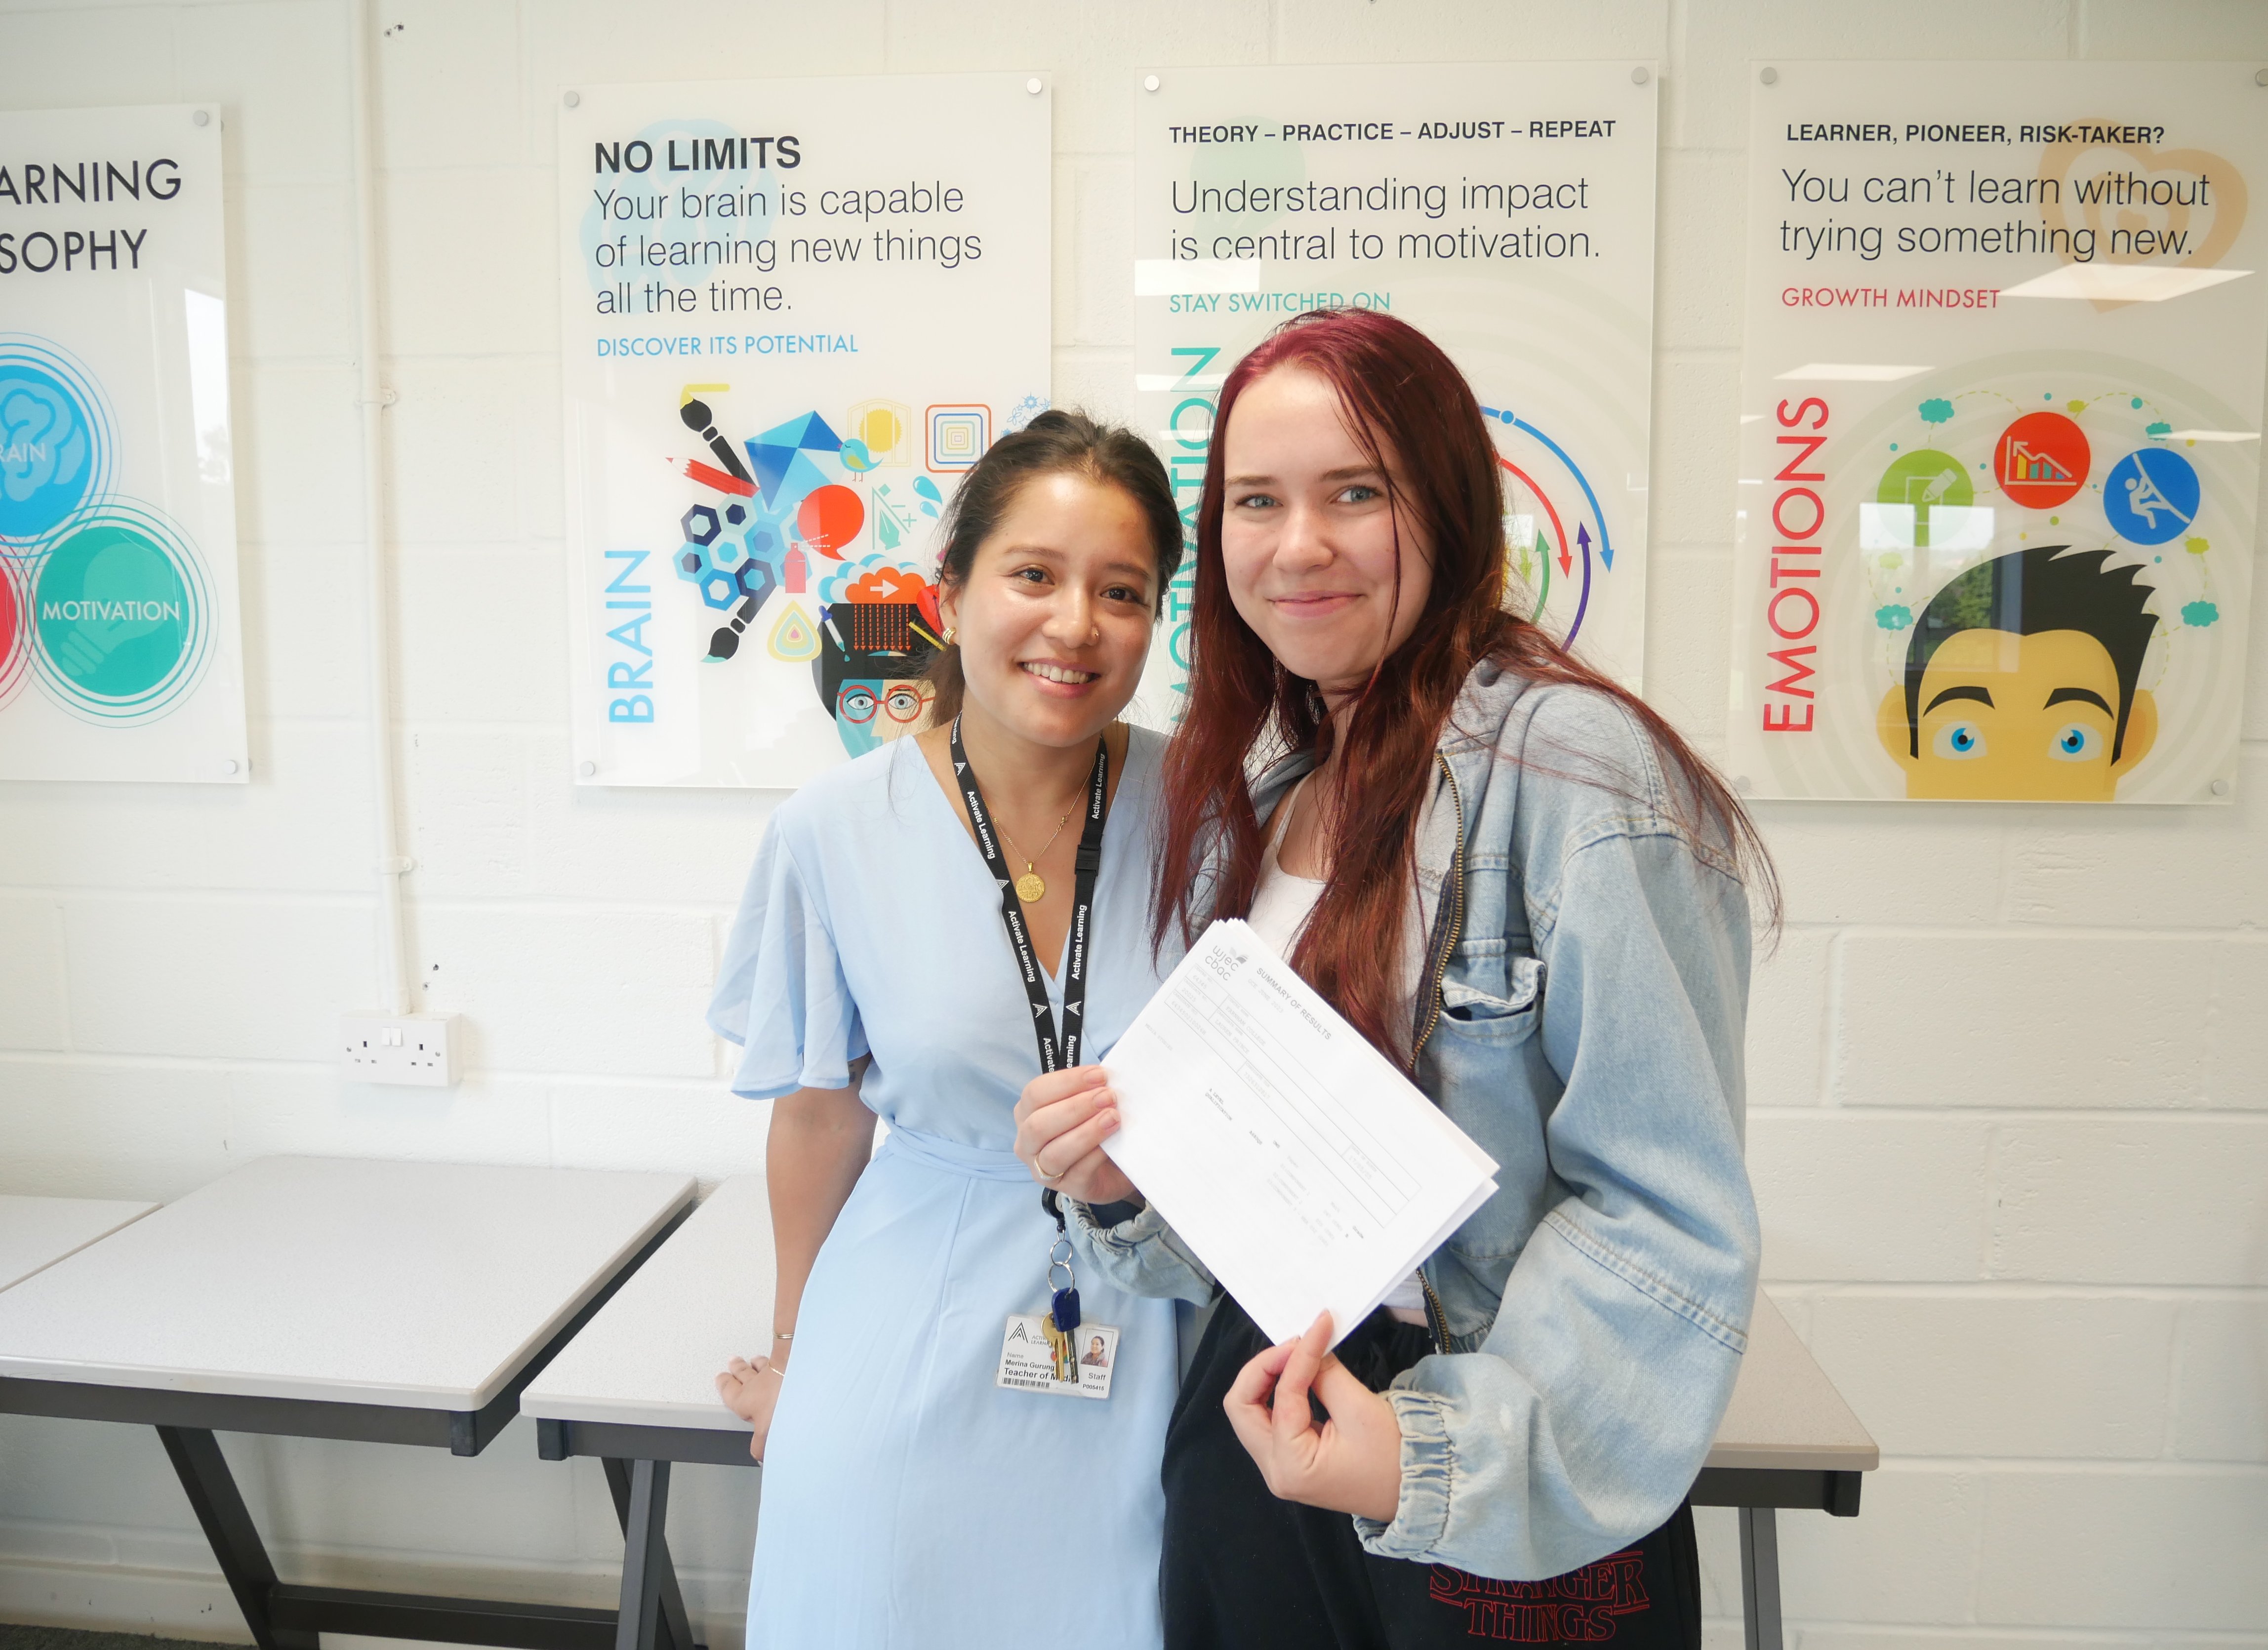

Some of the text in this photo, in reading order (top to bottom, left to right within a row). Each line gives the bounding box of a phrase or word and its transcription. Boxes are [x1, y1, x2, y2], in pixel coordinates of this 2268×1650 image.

[1169, 125, 1258, 143] THEORY
[1283, 123, 1393, 141] PRACTICE
[1418, 121, 1505, 139] ADJUST
[1530, 120, 1616, 138] REPEAT
[1787, 124, 2164, 146] LEARNER, PIONEER, RISK-TAKER?
[595, 136, 801, 173] NO LIMITS
[0, 159, 181, 205] ARNING
[1173, 177, 1588, 219] Understanding impact
[1782, 169, 2210, 205] You can’t learn without
[594, 180, 963, 222] Your brain is capable
[0, 229, 147, 274] SOPHY
[596, 229, 981, 272] of learning new things
[1171, 225, 1599, 262] is central to motivation.
[1780, 218, 2191, 263] trying something new.
[597, 280, 791, 314] all the time.
[1169, 292, 1390, 313] STAY SWITCHED ON
[1782, 287, 2001, 309] GROWTH MINDSET
[598, 334, 858, 357] DISCOVER ITS POTENTIAL
[1763, 397, 1830, 732] EMOTIONS
[43, 601, 180, 620] MOTIVATION
[604, 550, 654, 724] BRAIN
[1092, 753, 1105, 819] Activate Learning
[968, 791, 995, 859] Activate Learning
[1008, 911, 1035, 983] Activate Learning
[1071, 905, 1087, 980] Activate Learning
[1211, 945, 1238, 972] wjec
[1204, 954, 1232, 981] cbac
[1256, 967, 1332, 1040] SUMMARY OF RESULTS
[1258, 988, 1271, 1001] JUNE
[1215, 1019, 1250, 1054] LAUREN PRINCE
[1225, 1006, 1266, 1046] FARNHAM COLLEGE
[1043, 1038, 1055, 1073] Activate
[1066, 1035, 1076, 1068] earning
[1004, 1368, 1038, 1378] Teacher
[1051, 1374, 1071, 1382] Mdi
[1029, 1363, 1054, 1372] Gurung
[1464, 1598, 1615, 1642] THINGS
